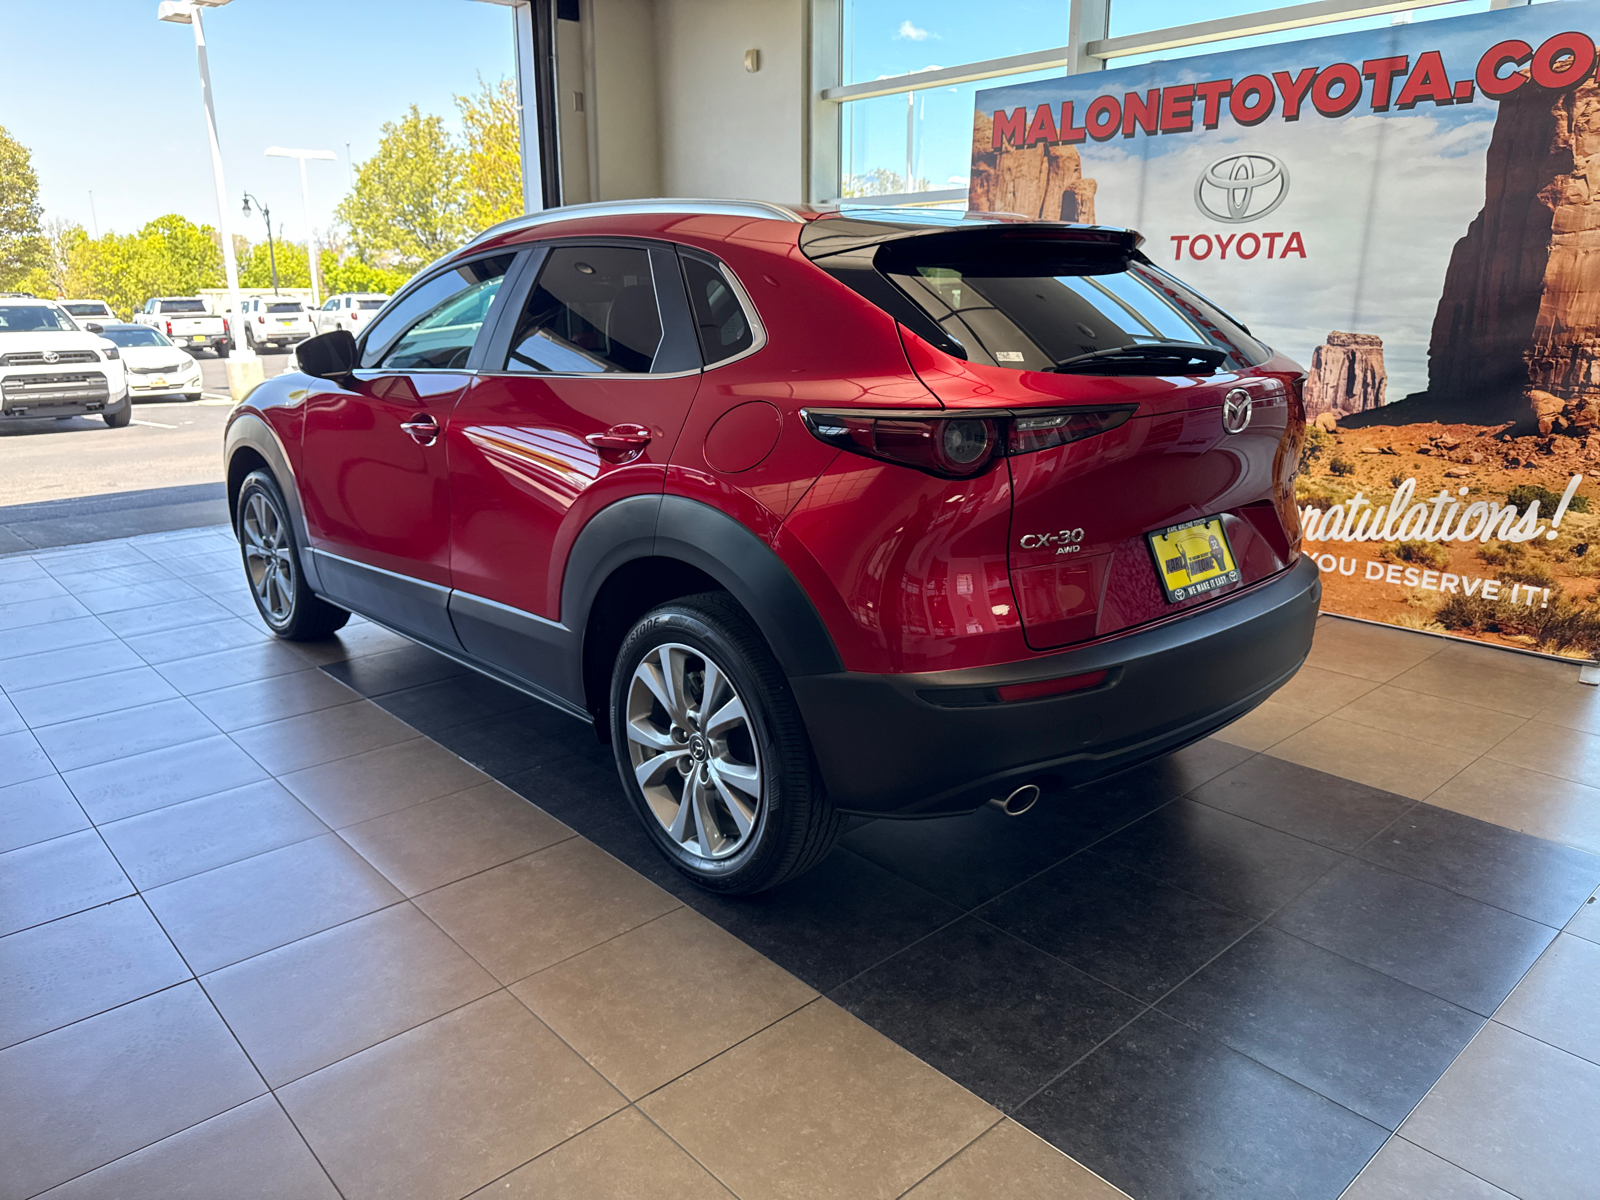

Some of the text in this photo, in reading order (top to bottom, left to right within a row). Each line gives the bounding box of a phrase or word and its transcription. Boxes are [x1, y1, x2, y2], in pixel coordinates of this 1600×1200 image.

[992, 31, 1600, 149] MALONETOYOTA.CO
[1170, 232, 1307, 261] TOYOTA
[1298, 474, 1583, 543] ratulations!
[1020, 527, 1085, 549] CX-30
[1055, 545, 1081, 555] AWD
[1187, 575, 1227, 595] WE MAKE IT EASY
[1365, 561, 1501, 601] DESERVE
[1510, 583, 1551, 609] IT!
